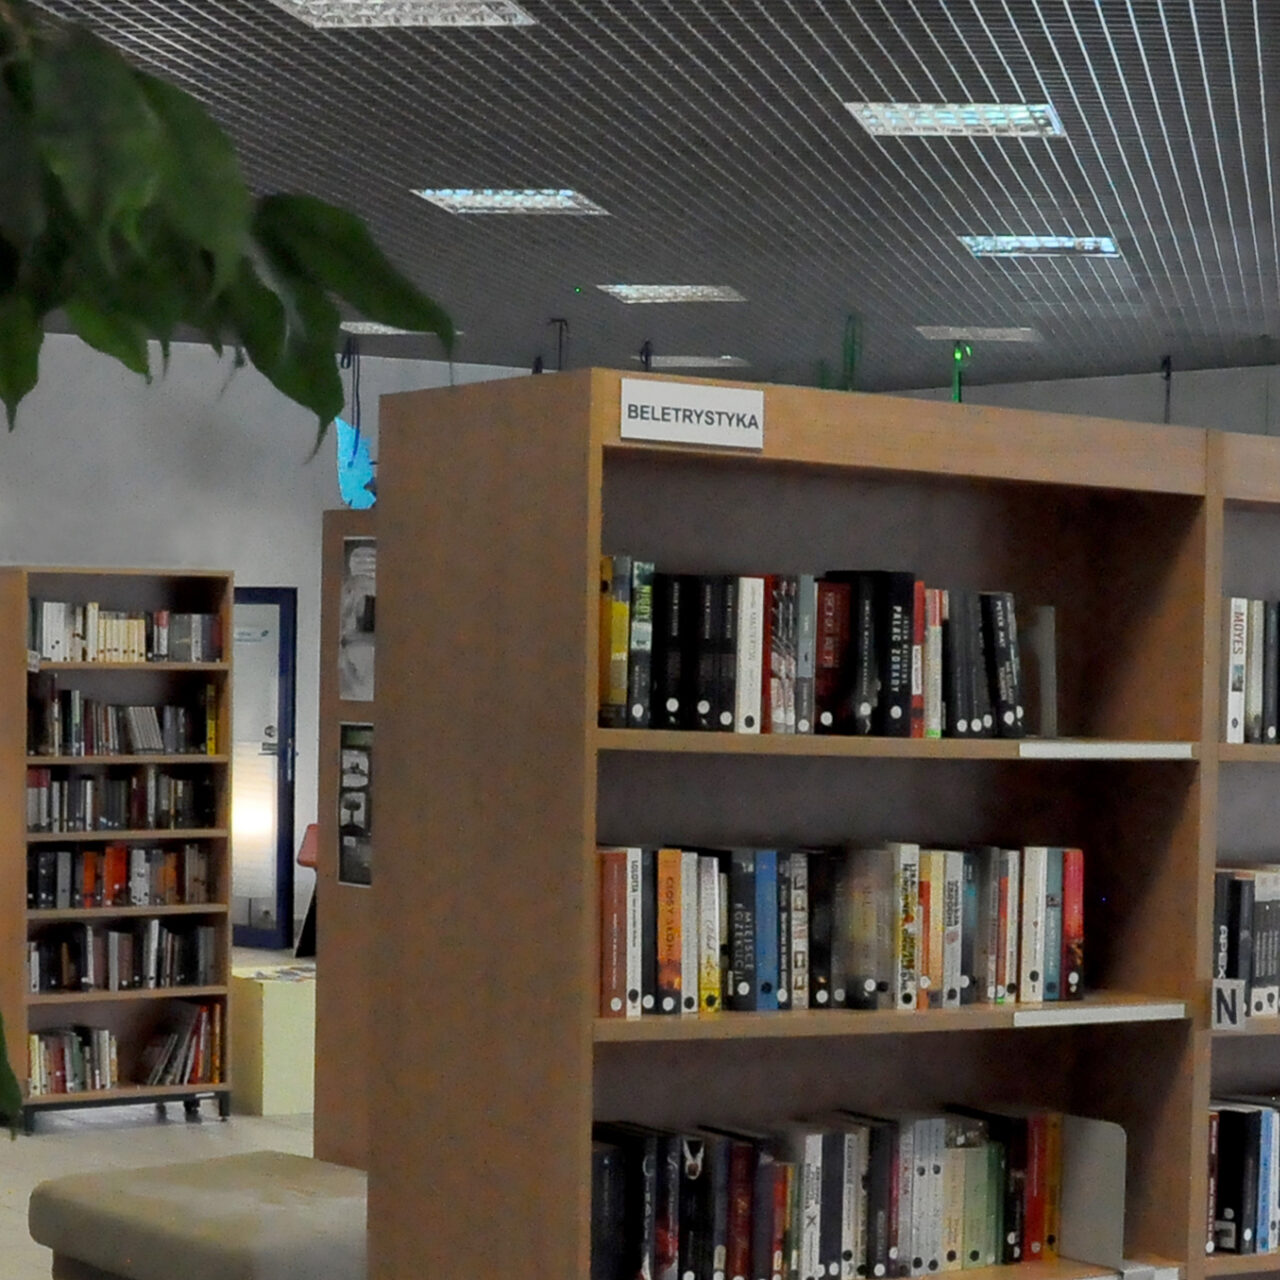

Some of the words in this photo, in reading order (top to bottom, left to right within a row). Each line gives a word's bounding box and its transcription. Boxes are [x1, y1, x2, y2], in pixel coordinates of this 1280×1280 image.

[626, 403, 760, 431] BELETRYSTYKA
[1232, 611, 1245, 656] MOYES
[1216, 986, 1238, 1026] N
